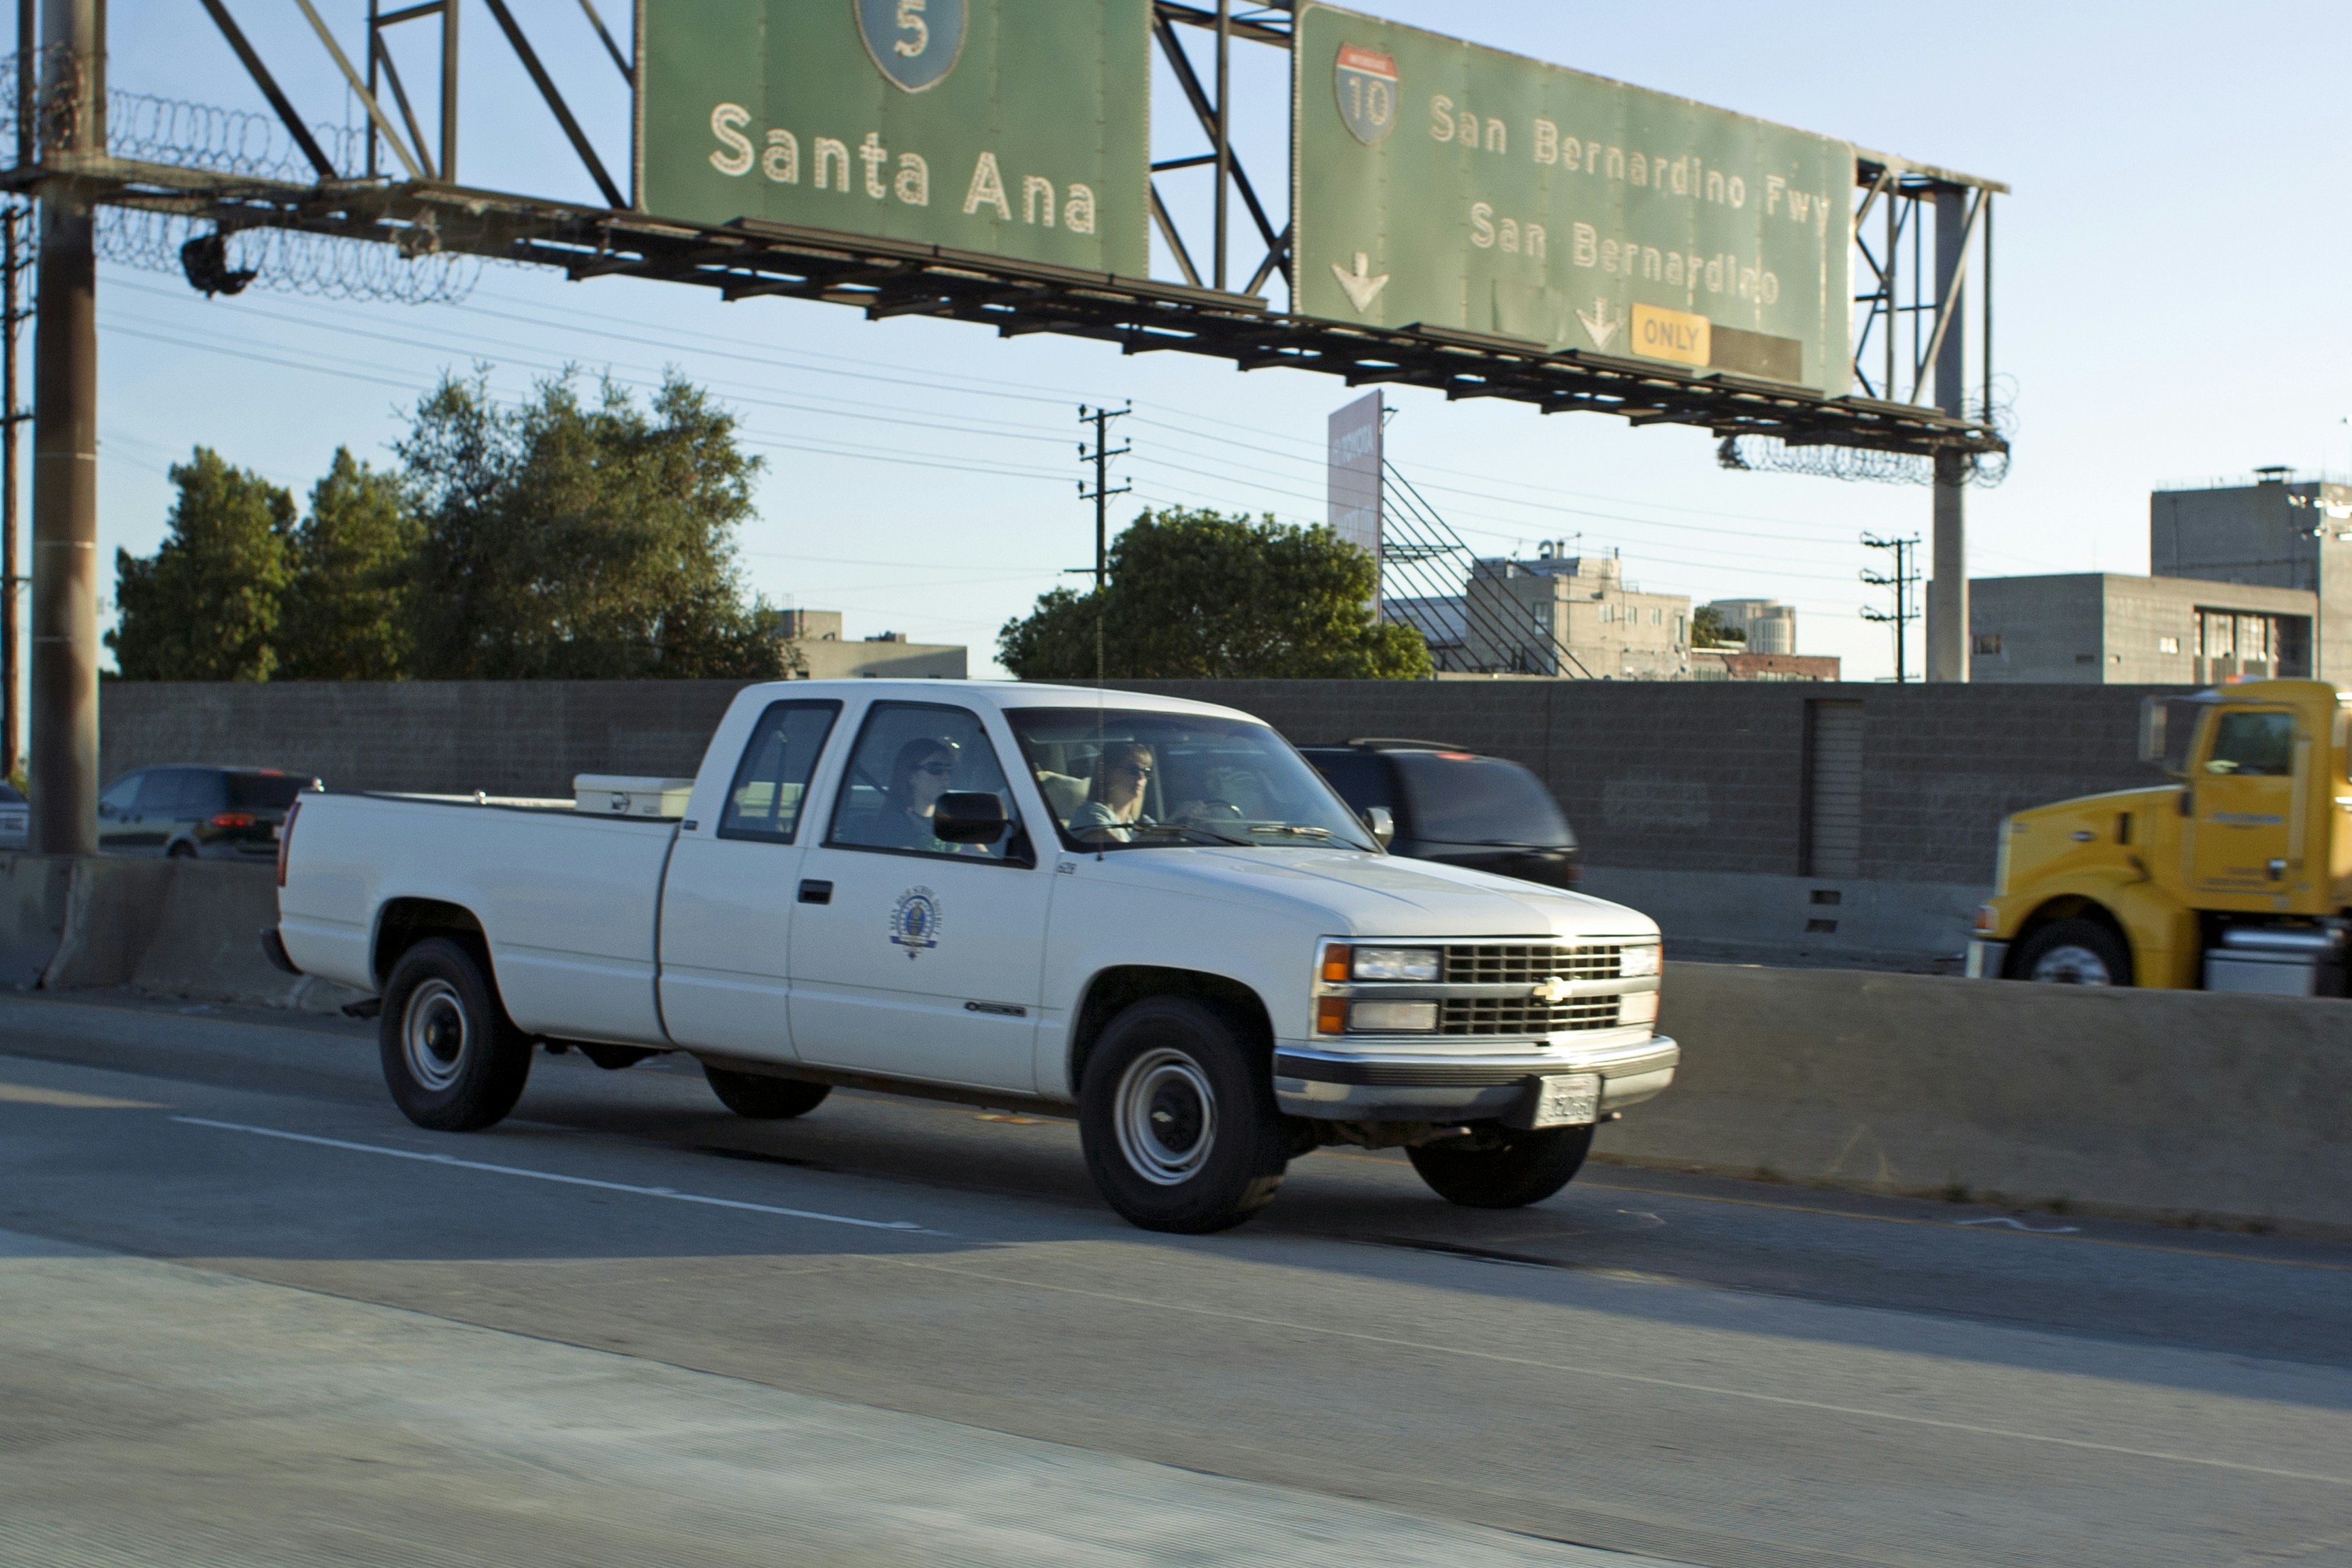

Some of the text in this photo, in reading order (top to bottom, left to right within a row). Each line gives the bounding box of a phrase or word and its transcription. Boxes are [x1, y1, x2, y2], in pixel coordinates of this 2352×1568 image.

[892, 0, 930, 56] 5
[1348, 75, 1390, 125] 10
[709, 102, 1096, 235] Santa Ana
[1431, 93, 1832, 238] San Bernardino Fwy
[1471, 201, 1780, 306] San Bernardino
[1644, 318, 1700, 353] ONLY
